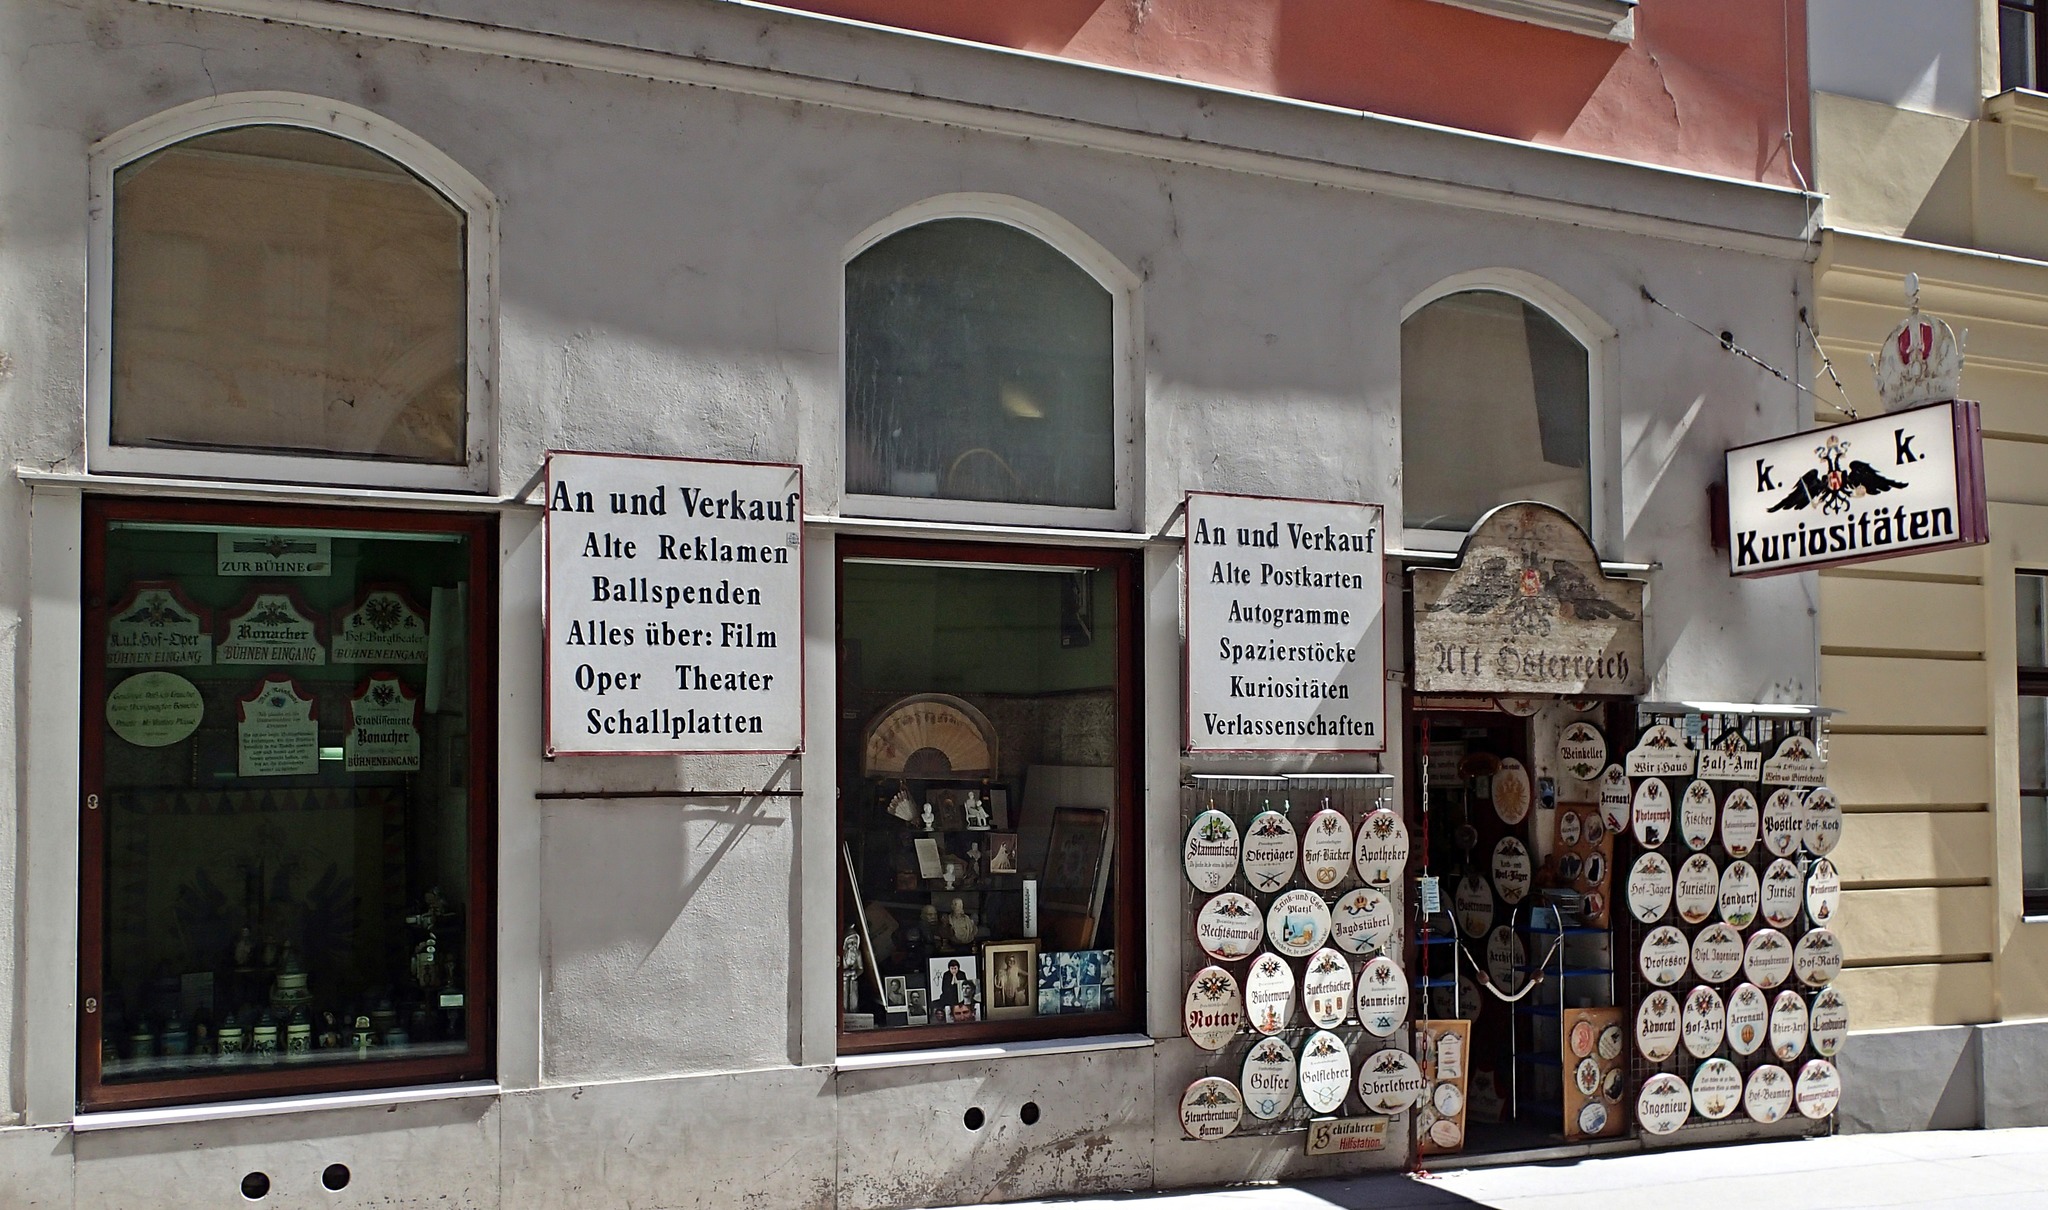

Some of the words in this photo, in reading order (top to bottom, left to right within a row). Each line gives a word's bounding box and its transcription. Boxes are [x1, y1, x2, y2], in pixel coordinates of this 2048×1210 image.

[1756, 459, 1783, 493] k.
[1894, 428, 1925, 465] k.
[549, 480, 594, 513] An
[610, 485, 667, 516] und
[680, 487, 800, 522] Verkauf
[1194, 518, 1226, 545] An
[1237, 522, 1279, 548] und
[1286, 523, 1376, 553] Verkauf
[1737, 505, 1953, 567] Kuriositäten
[582, 531, 636, 559] Alte
[658, 534, 789, 564] Reklamen
[222, 562, 251, 572] ZUR
[256, 561, 306, 572] BÜHNE
[1210, 561, 1251, 585] Alte
[1261, 563, 1363, 589] Postkarten
[592, 576, 761, 609] Ballspenden
[1228, 599, 1350, 627] Autogramme
[238, 625, 309, 640] Ronacher
[567, 620, 634, 646] Alles
[645, 621, 712, 646] über:
[721, 622, 777, 648] Film
[155, 649, 202, 664] EINGANG
[225, 646, 267, 660] BÜHNEN
[271, 646, 316, 663] EINGANG
[1220, 637, 1356, 663] Spazierstöcke
[1434, 643, 1482, 676] Alt
[1496, 637, 1629, 684] Österreich
[575, 664, 641, 695] Oper
[675, 665, 773, 691] Theater
[1230, 675, 1349, 699] Kuriositäten
[587, 708, 763, 739] Schallplatten
[1203, 713, 1375, 736] Verlassenschaften
[358, 728, 409, 746] Ronacher
[348, 754, 418, 767] BÜHNENEINGANG
[1561, 747, 1603, 760] Weinkeller
[1635, 808, 1670, 823] Photograph
[1685, 810, 1712, 827] Fischer
[1764, 816, 1803, 836] Postler
[1187, 838, 1238, 860] Stammtisch
[1245, 849, 1294, 862] Oberjäger
[1306, 848, 1350, 864] Hof-Bäcker
[1359, 845, 1406, 864] Apotheker
[1679, 880, 1716, 898] Juristin
[1767, 884, 1796, 901] Jurist
[1722, 890, 1757, 907] Landarzt
[1287, 905, 1312, 914] Platzl
[1201, 924, 1259, 940] Rechtsanwalt
[1335, 915, 1390, 937] Jagdstüberl
[1489, 950, 1523, 964] Architkt
[1645, 955, 1686, 971] Professor
[1360, 994, 1406, 1010] Baumeister
[1189, 1010, 1238, 1030] Notar
[1642, 1018, 1676, 1036] Advocat
[1685, 1019, 1723, 1035] Hof-Arzt
[1250, 1073, 1289, 1091] Golfer
[1302, 1068, 1349, 1083] Golflehrer
[1361, 1077, 1419, 1095] Oberlehrer
[1642, 1099, 1687, 1117] Ingenieur
